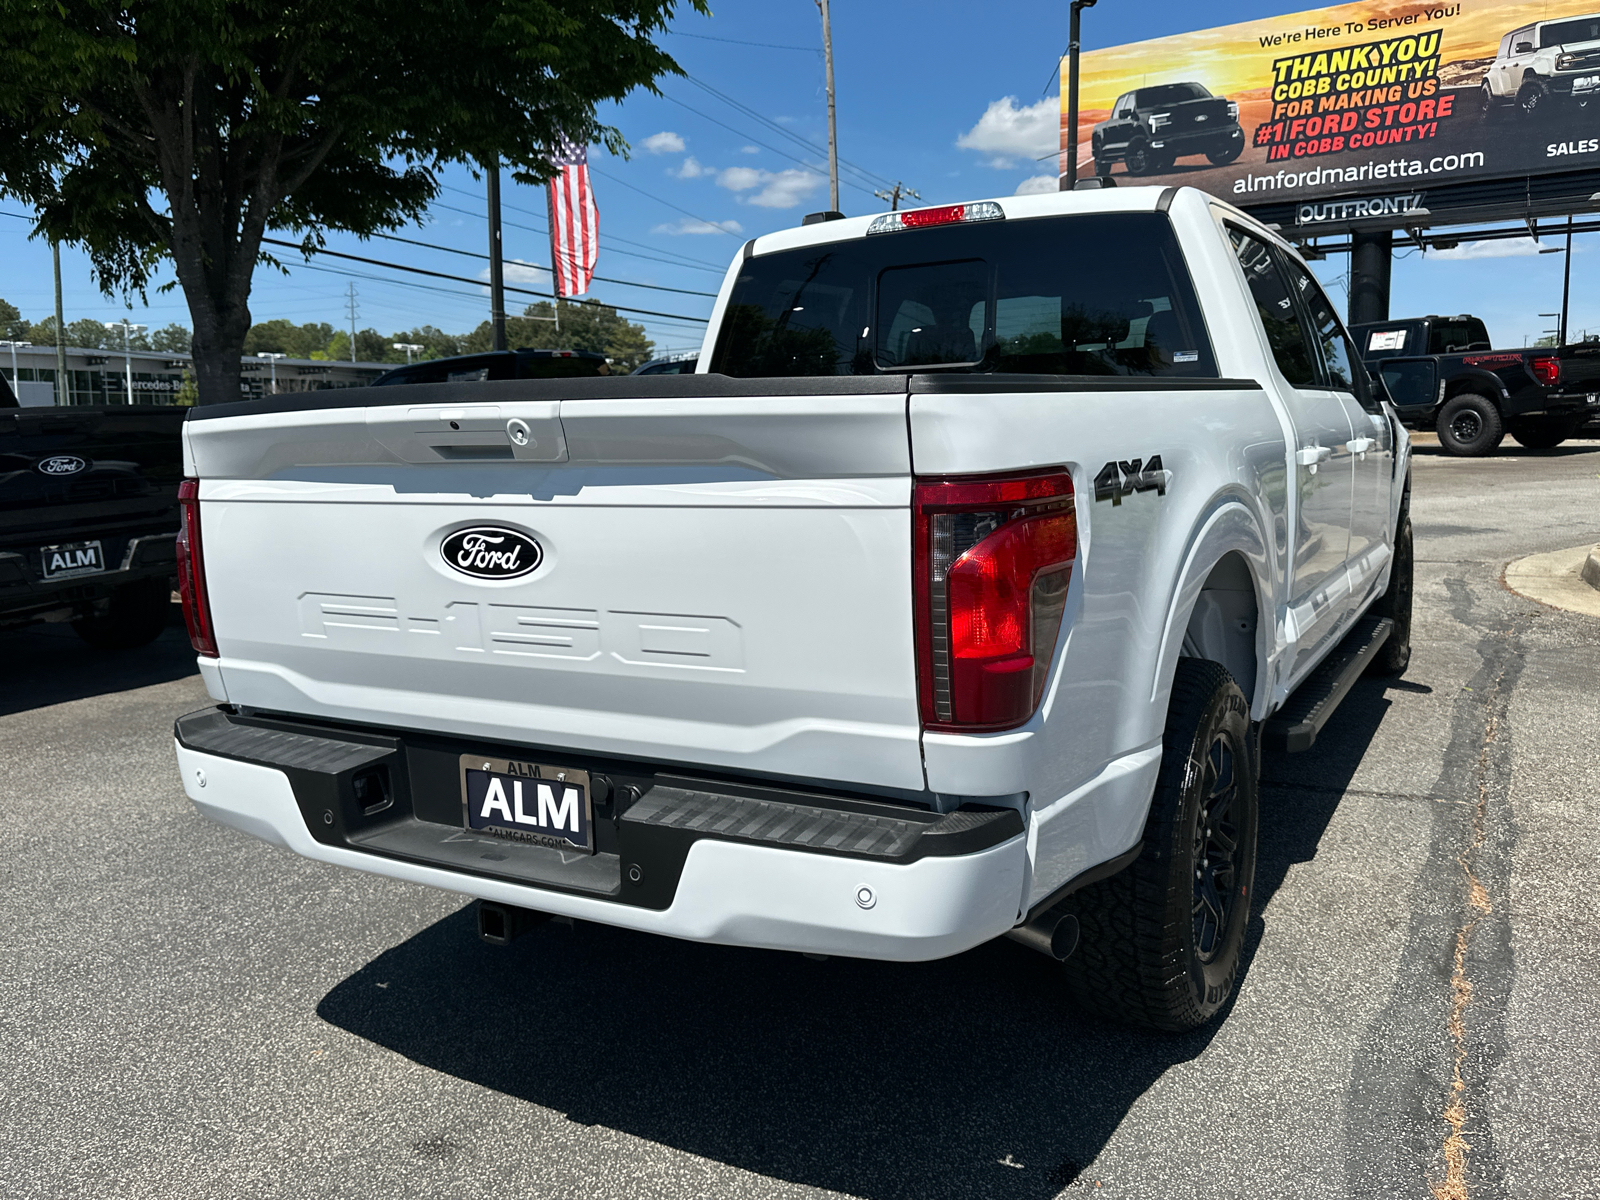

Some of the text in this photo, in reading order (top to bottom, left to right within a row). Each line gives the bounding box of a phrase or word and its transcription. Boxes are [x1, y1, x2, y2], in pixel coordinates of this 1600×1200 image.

[1259, 3, 1461, 48] We're Here To Server You!
[1275, 32, 1439, 82] THANK YOU
[1274, 58, 1437, 101] COBB COUNTY!
[1274, 79, 1437, 120] FOR MAKING US
[1256, 94, 1456, 144] #1 FORD STORE
[1269, 122, 1438, 160] IN COBB COUNTY!
[1546, 138, 1599, 157] SALES
[1233, 151, 1485, 194] almfordmarietta.com
[46, 458, 78, 472] Ford
[50, 548, 97, 570] ALM
[457, 533, 522, 570] Ford
[297, 591, 747, 673] F-150
[507, 761, 542, 778] ALM
[480, 777, 579, 833] ALM
[493, 829, 562, 848] ALMCARS.COM
